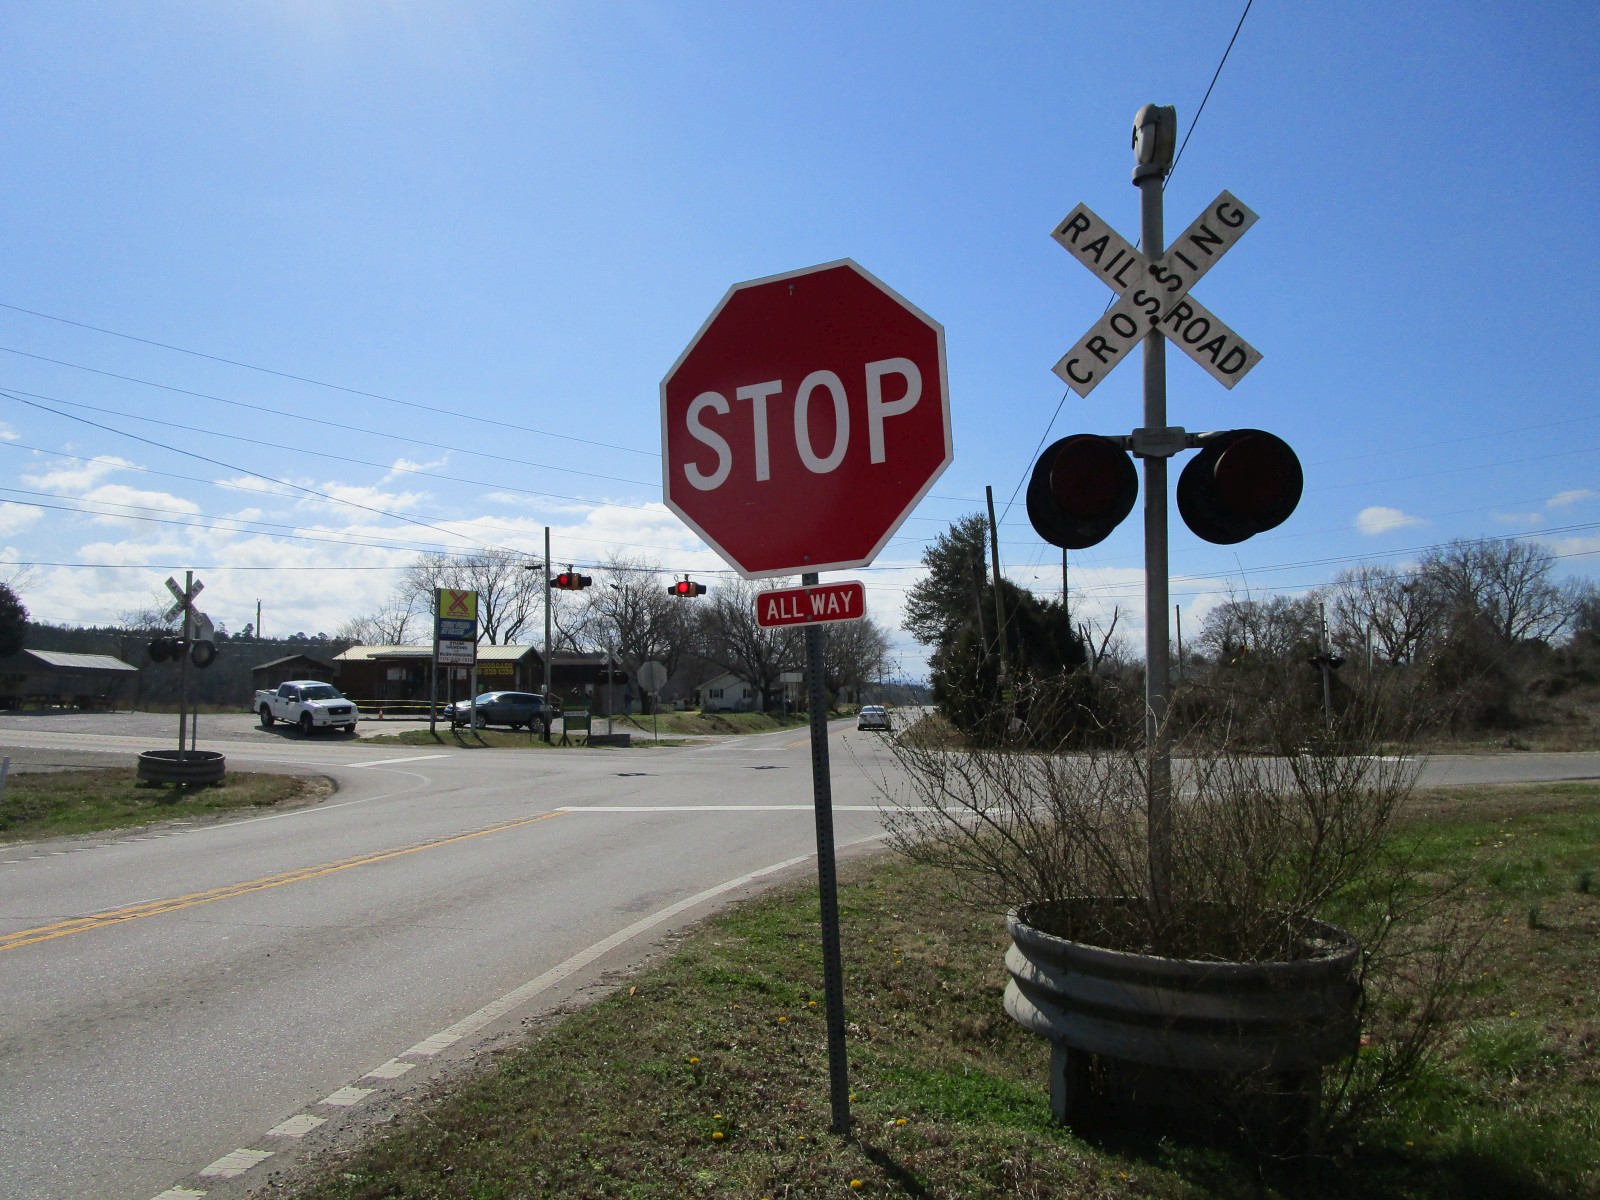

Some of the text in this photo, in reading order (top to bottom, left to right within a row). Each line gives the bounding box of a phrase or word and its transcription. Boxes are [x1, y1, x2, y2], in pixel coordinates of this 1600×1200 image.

[1061, 211, 1136, 289] RAIL
[1065, 202, 1245, 385] CROSSING
[1162, 300, 1248, 375] ROAD
[683, 356, 923, 491] STOP
[165, 582, 203, 622] CROSNG
[766, 591, 853, 621] ALL WAY
